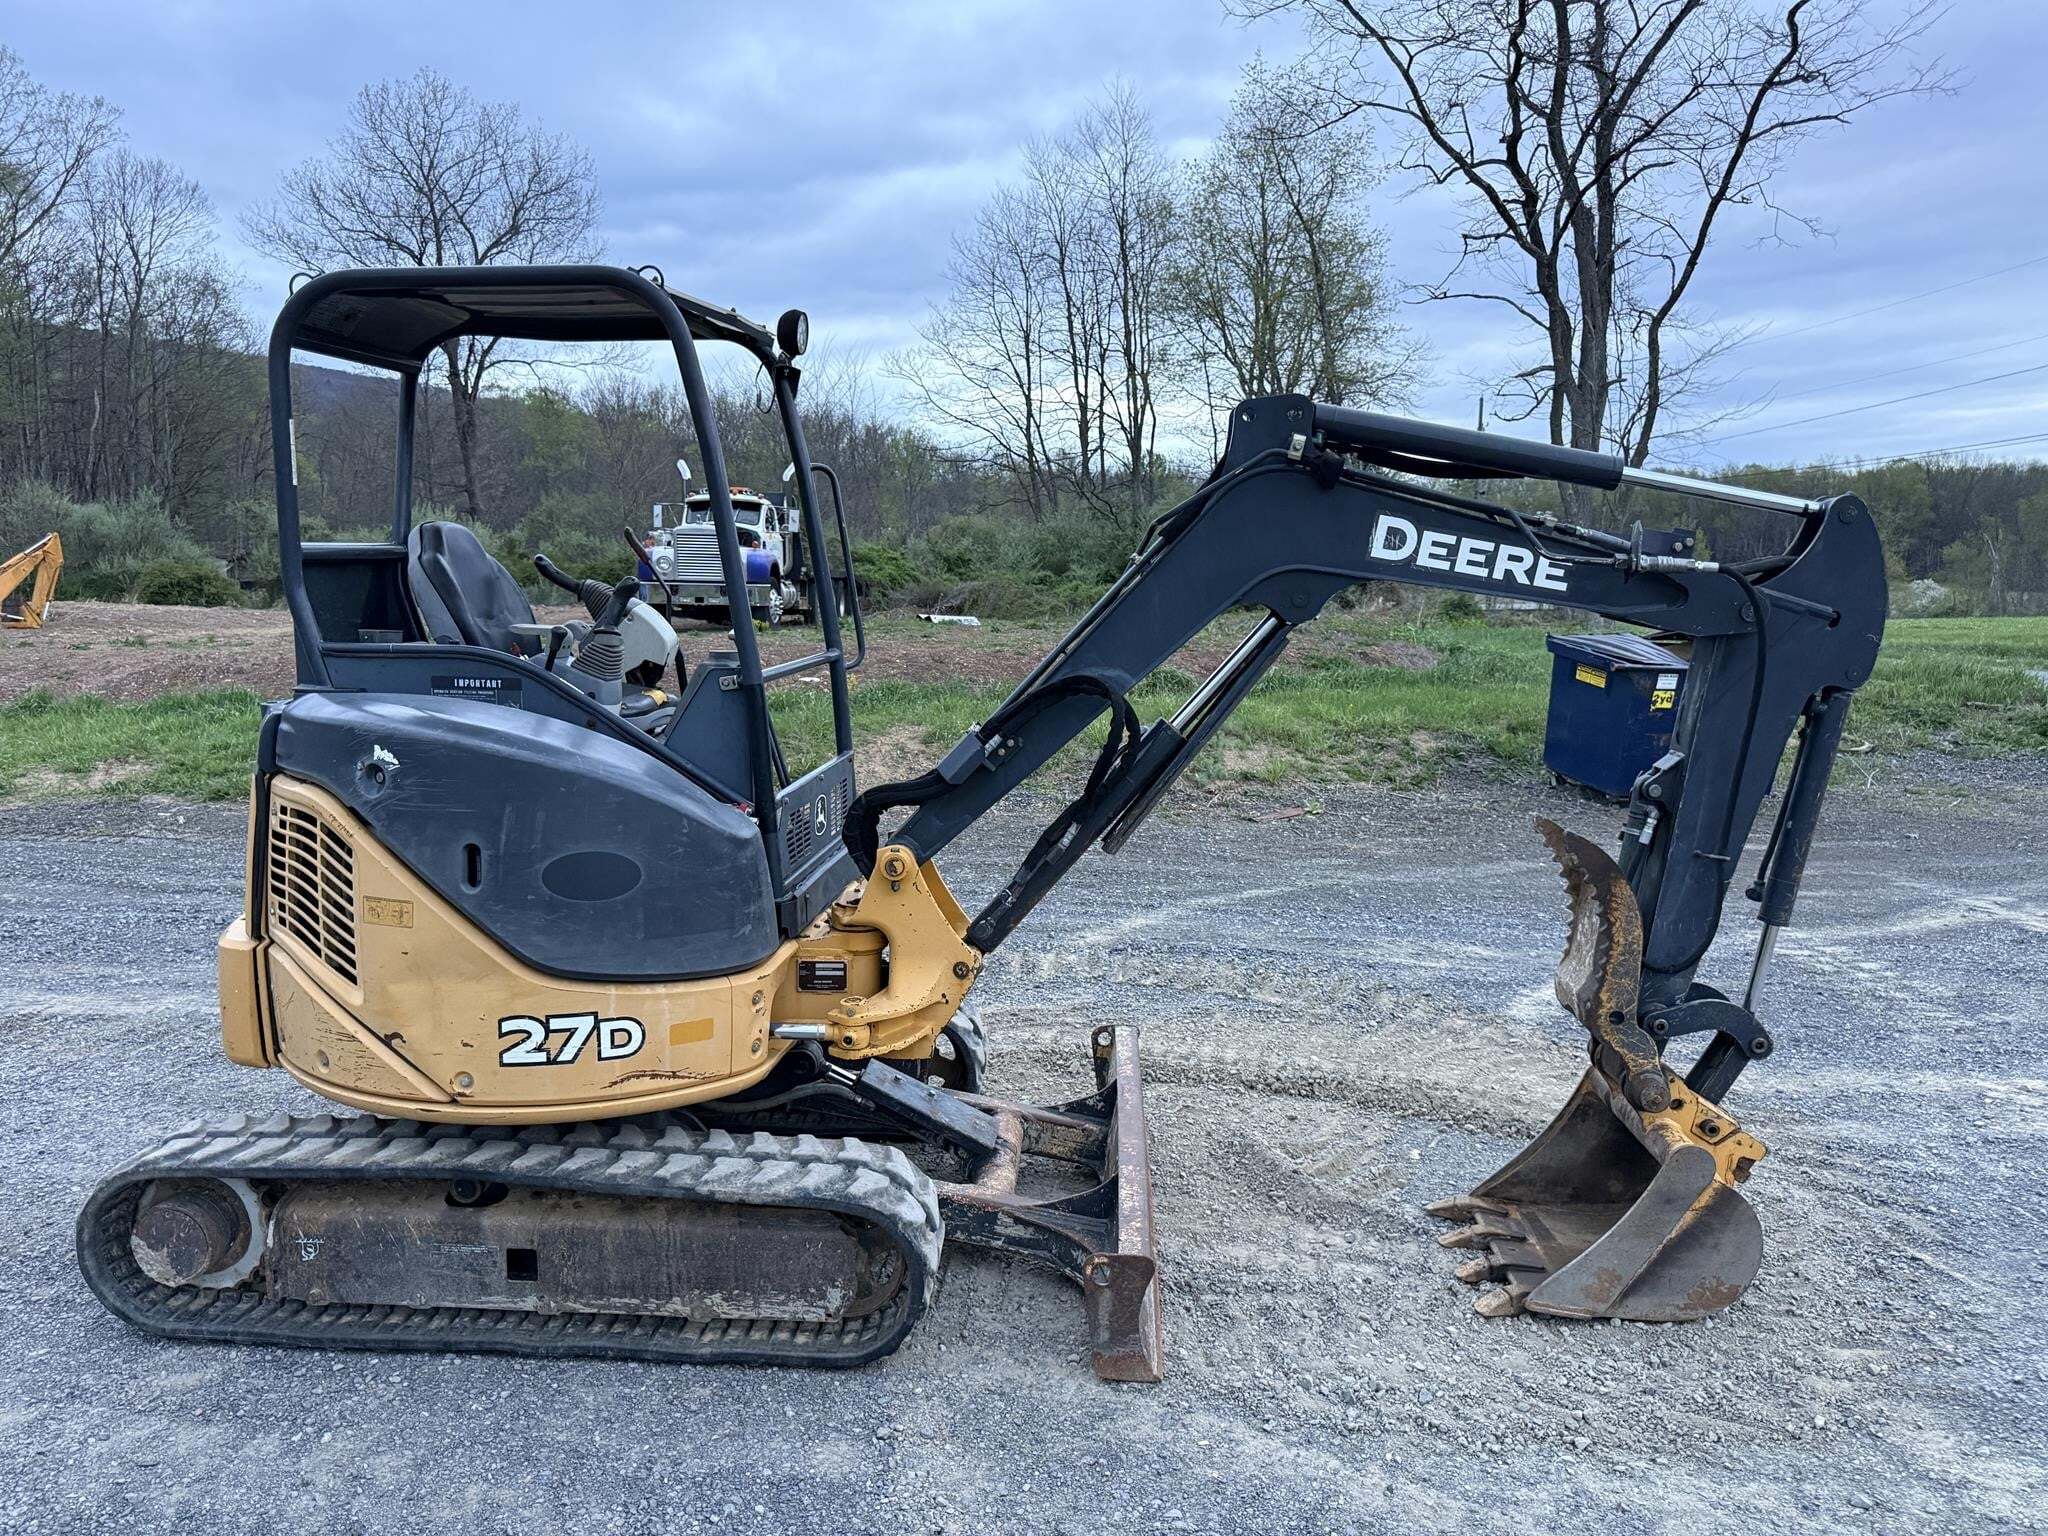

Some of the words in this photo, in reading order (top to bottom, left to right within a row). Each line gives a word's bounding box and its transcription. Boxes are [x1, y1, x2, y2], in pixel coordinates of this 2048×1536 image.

[1370, 514, 1573, 592] DEERE
[454, 678, 502, 688] IMPORTANT
[1652, 693, 1673, 705] 2yd
[498, 1011, 646, 1067] 27D
